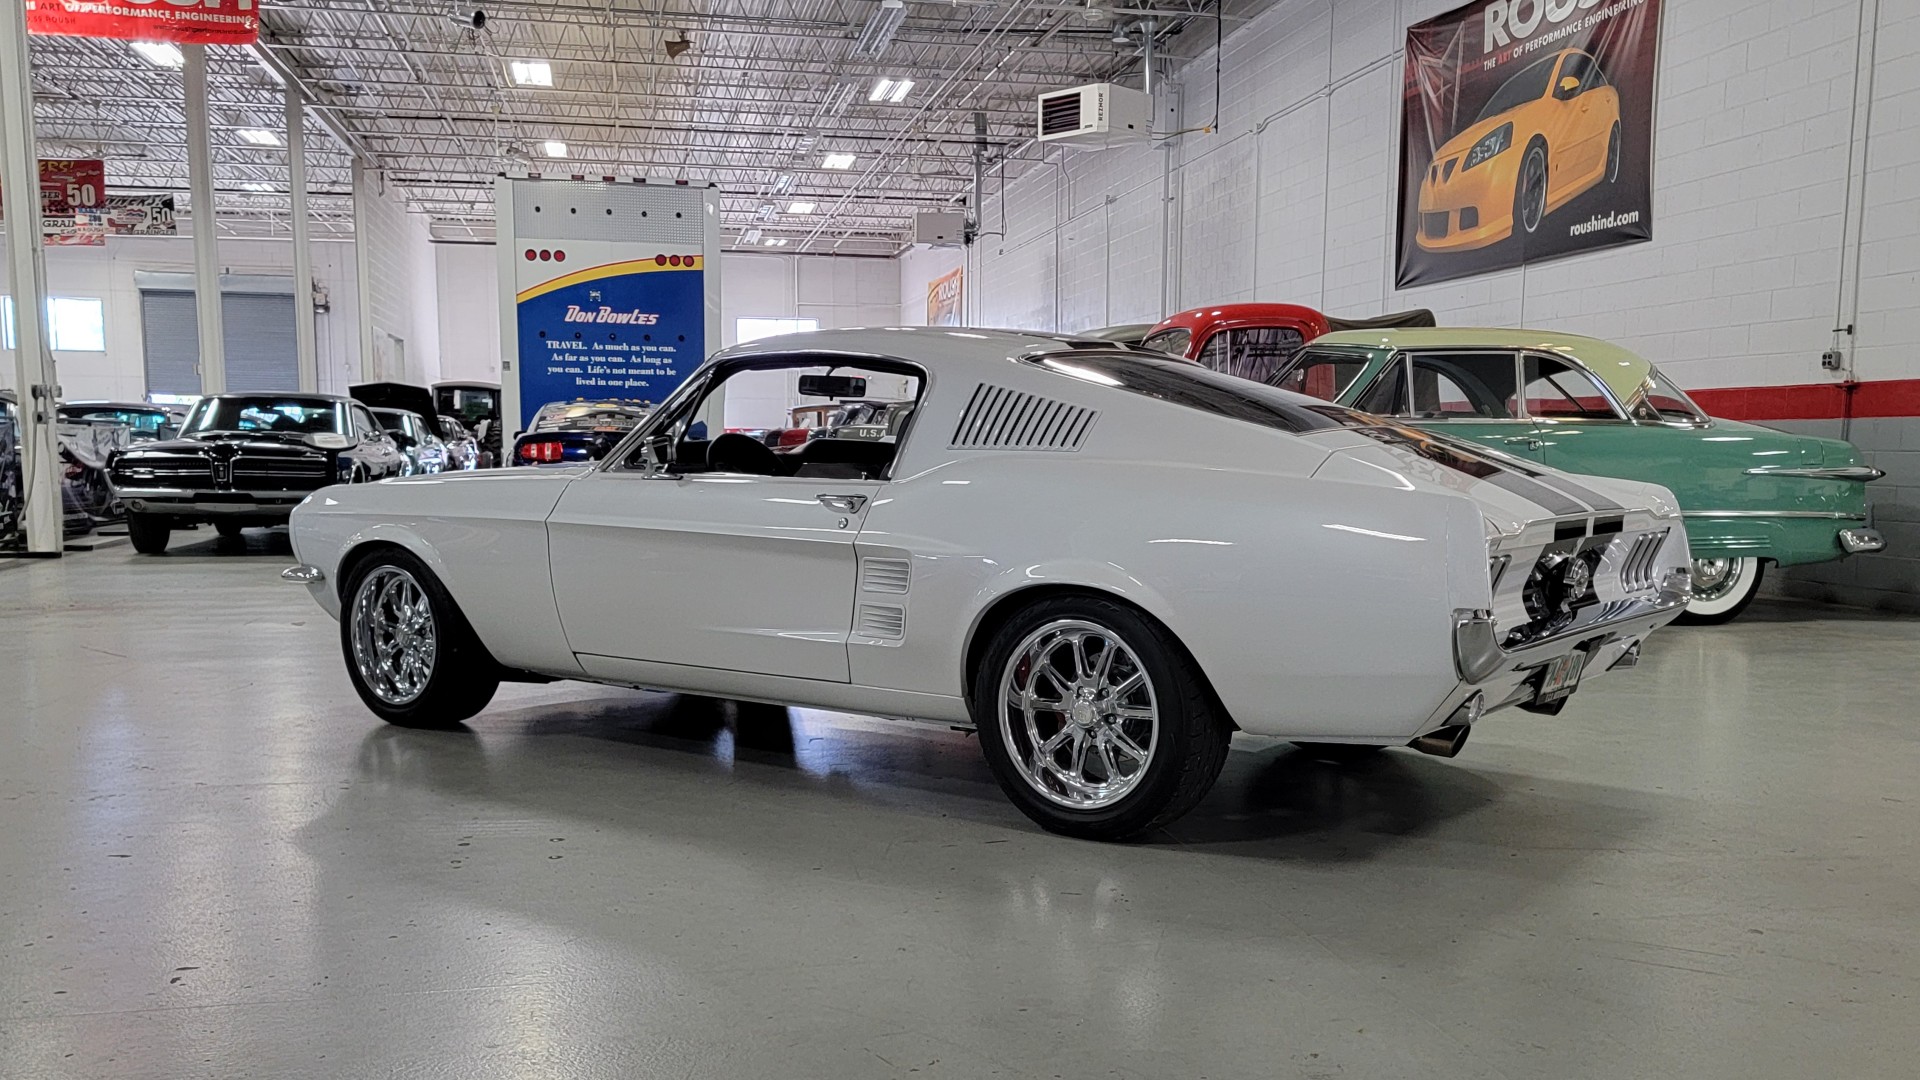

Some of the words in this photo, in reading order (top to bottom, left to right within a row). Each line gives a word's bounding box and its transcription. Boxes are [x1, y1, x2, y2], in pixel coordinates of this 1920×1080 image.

[40, 2, 60, 12] ART
[81, 3, 171, 19] PERFORMANCE
[175, 11, 252, 24] ENGINEERING
[1484, 58, 1497, 71] THE
[1497, 52, 1512, 65] ART
[1513, 46, 1524, 58] OF
[1525, 22, 1582, 54] PERFORMANCE
[1584, 0, 1645, 28] ENGINEERIN
[66, 183, 96, 207] 50
[151, 207, 172, 225] 50
[1570, 210, 1639, 237] roushind.com
[546, 340, 588, 350] TRAVEL.
[592, 341, 604, 351] As
[605, 343, 629, 351] much
[641, 345, 657, 354] you
[551, 353, 563, 361] As
[564, 353, 578, 362] far
[590, 356, 606, 364] you
[629, 354, 641, 363] As
[643, 355, 662, 366] long
[547, 366, 563, 375] you
[587, 365, 611, 374] Life's
[628, 368, 655, 376] meant
[656, 368, 665, 376] to
[666, 367, 677, 376] be
[575, 377, 596, 386] lived
[597, 377, 607, 386] in
[625, 378, 650, 389] place.
